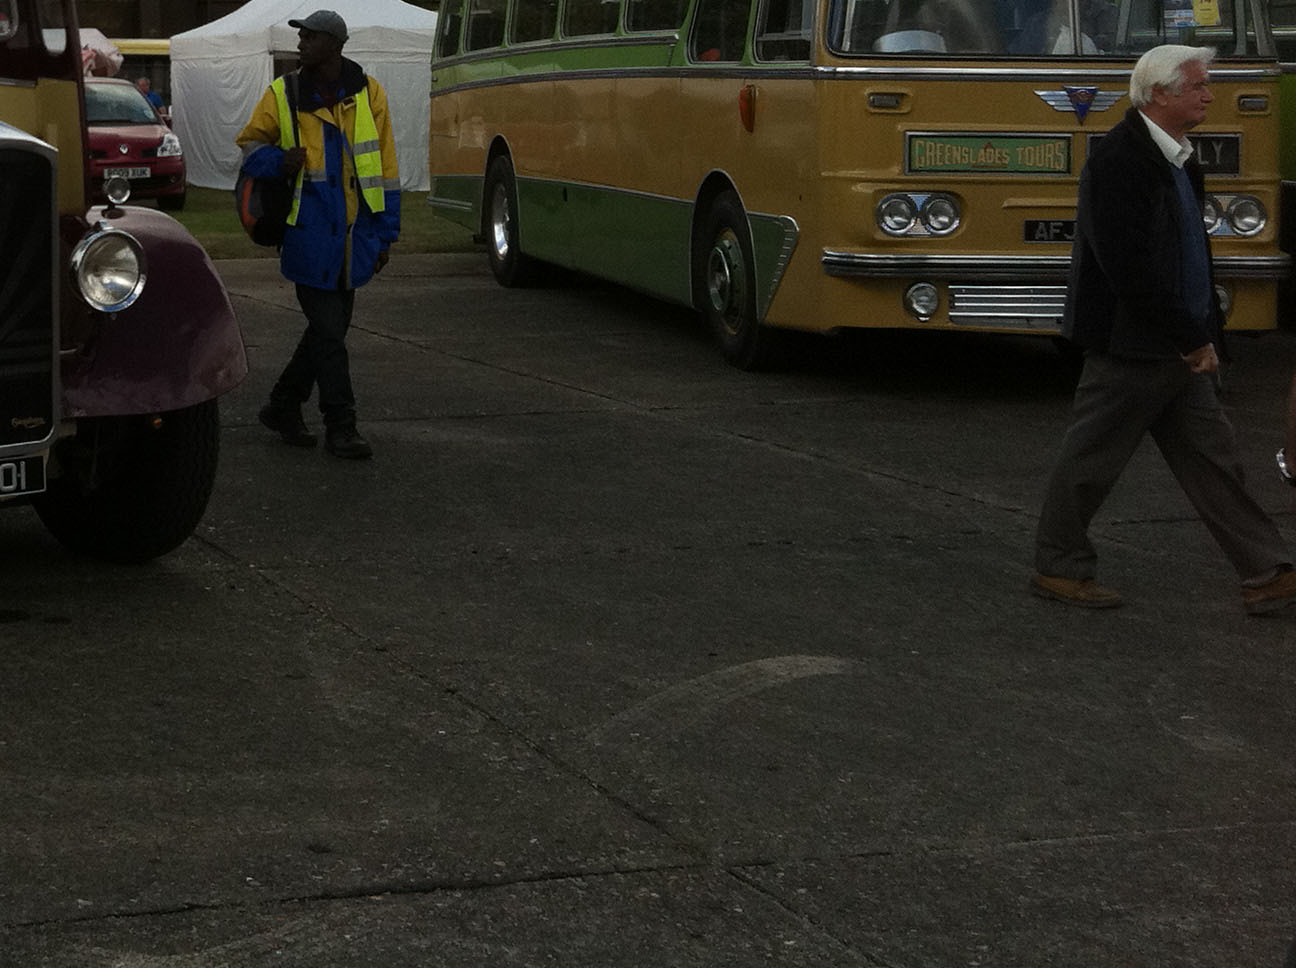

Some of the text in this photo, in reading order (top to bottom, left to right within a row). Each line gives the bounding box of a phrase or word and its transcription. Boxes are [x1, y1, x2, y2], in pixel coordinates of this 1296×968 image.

[914, 140, 1066, 170] GREENSLADES TOURS
[1034, 221, 1079, 241] AFJ
